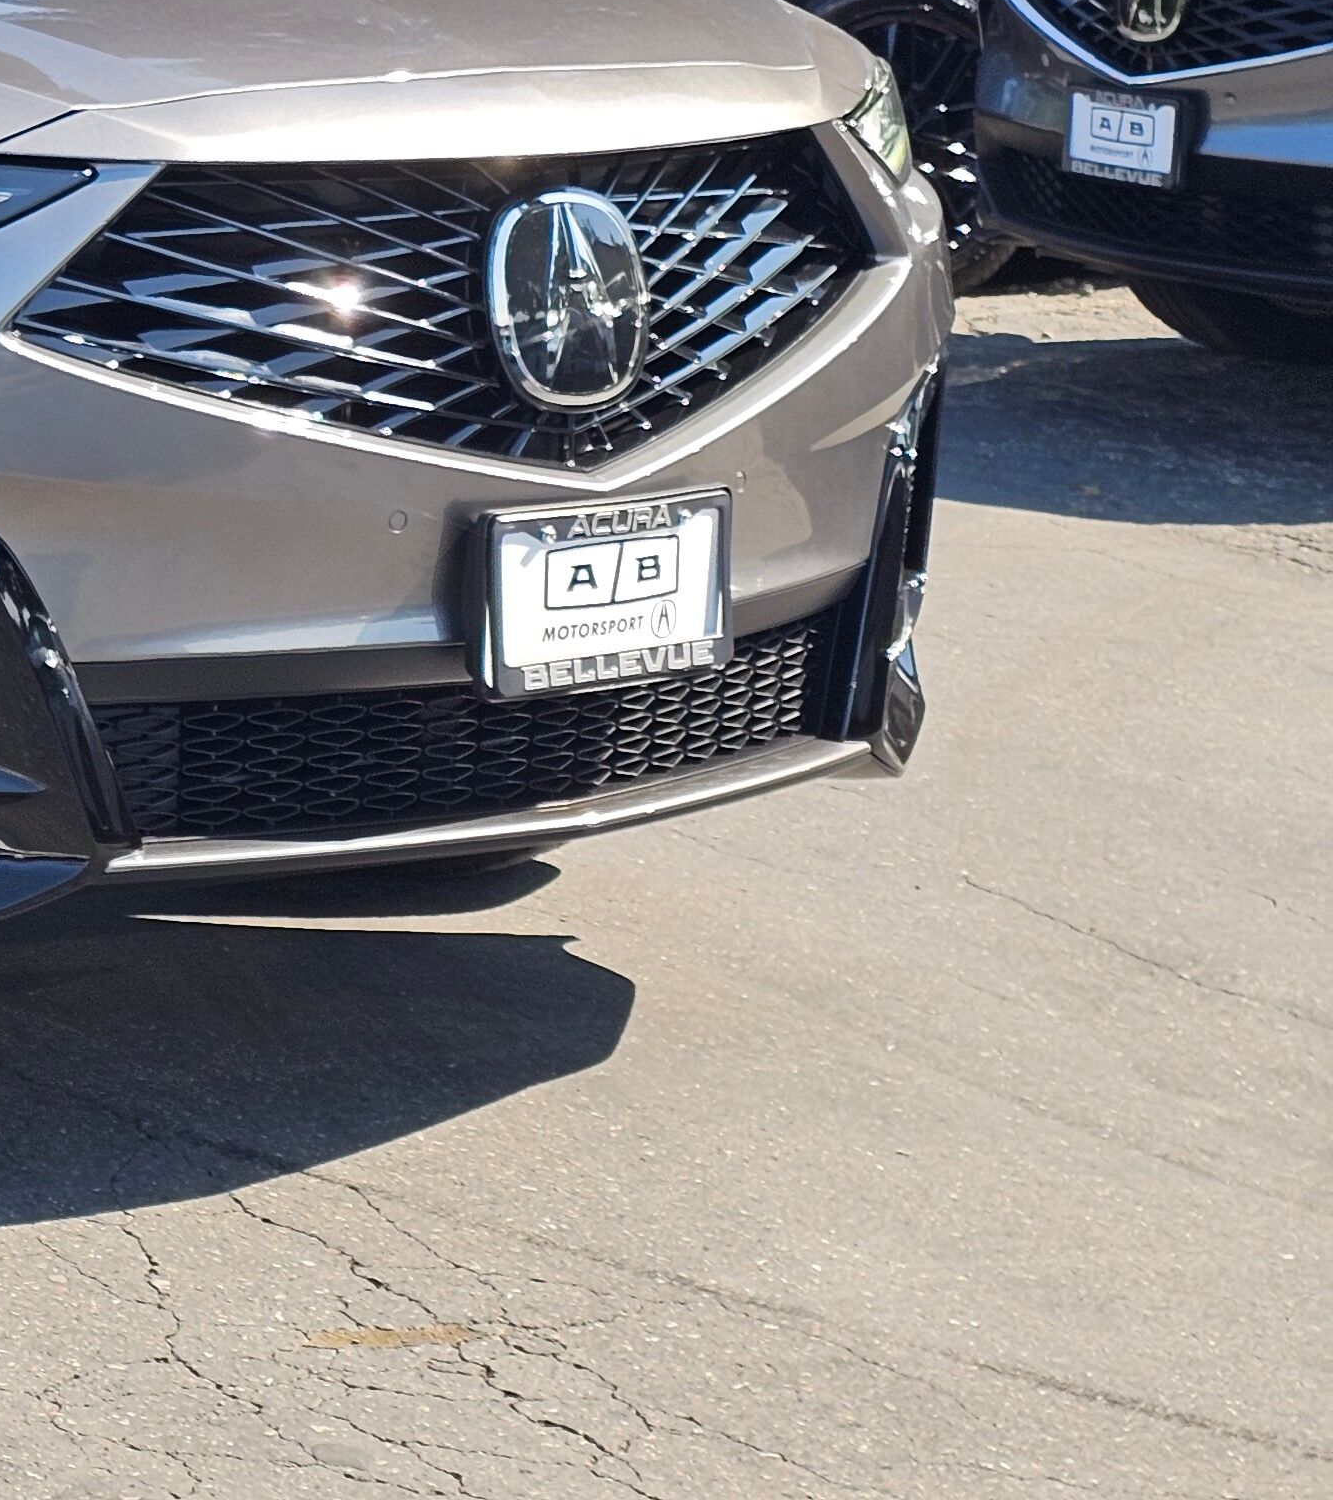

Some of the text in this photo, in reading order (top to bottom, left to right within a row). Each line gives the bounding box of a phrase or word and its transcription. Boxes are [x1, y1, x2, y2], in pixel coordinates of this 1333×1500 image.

[1095, 90, 1146, 109] ACURA
[1071, 160, 1165, 188] BELLEVUE
[566, 504, 673, 540] ACURA
[566, 555, 661, 592] A B
[542, 615, 644, 642] MOTORSPORT
[520, 640, 715, 692] BELLEVUE
